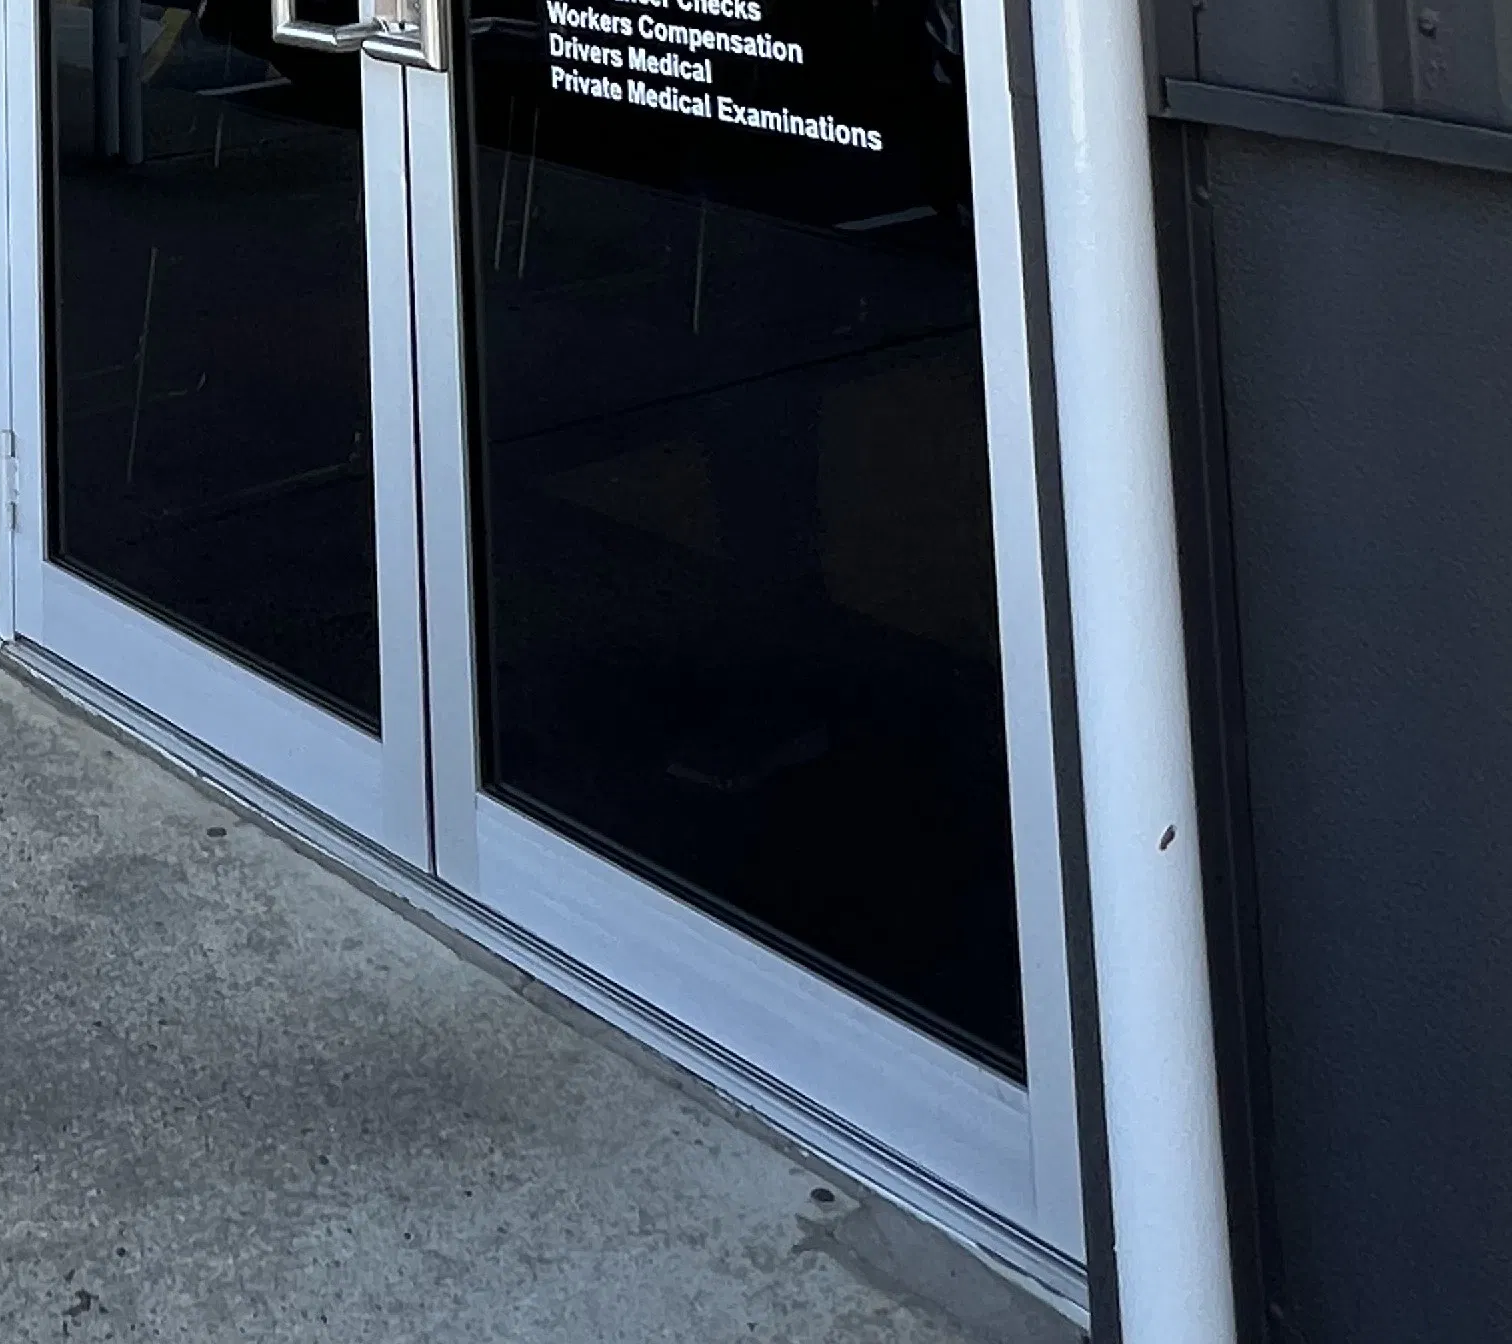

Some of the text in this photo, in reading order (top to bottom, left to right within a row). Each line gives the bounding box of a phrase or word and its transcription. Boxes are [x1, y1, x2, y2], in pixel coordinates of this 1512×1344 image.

[546, 0, 804, 64] Workers Compensation
[548, 32, 713, 84] Drivers Medical
[550, 64, 884, 152] Private Medical Examinations
